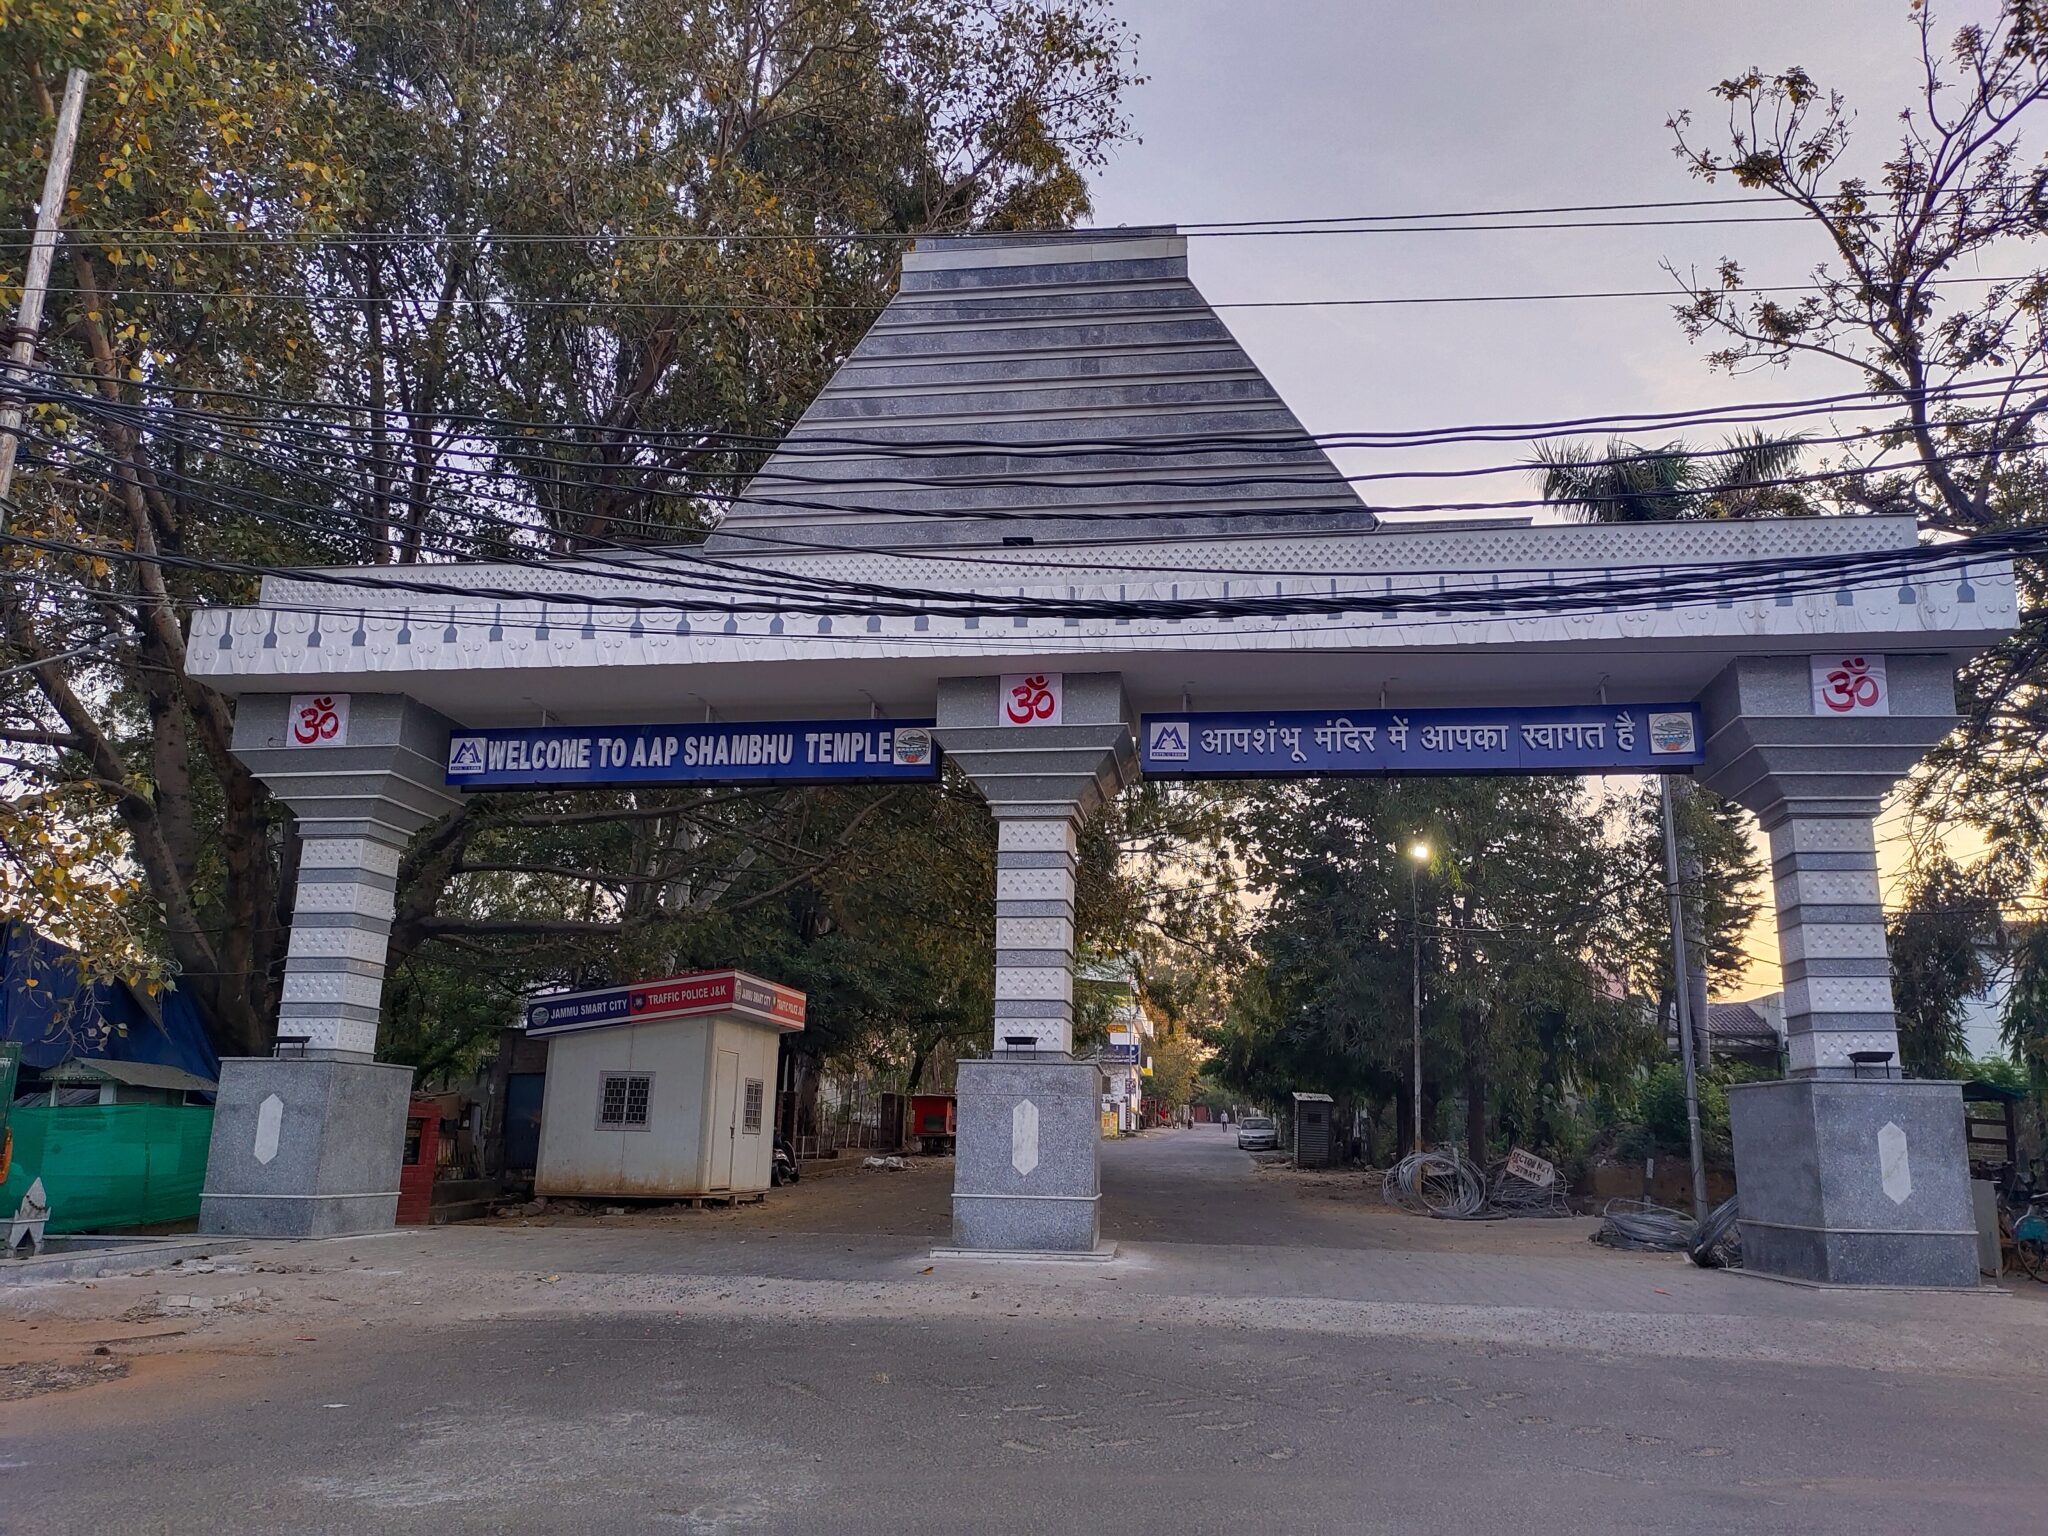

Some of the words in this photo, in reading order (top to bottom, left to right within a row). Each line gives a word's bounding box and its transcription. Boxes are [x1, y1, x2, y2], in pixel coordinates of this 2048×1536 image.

[488, 738, 592, 771] WELCOME
[598, 737, 627, 768] TO
[630, 736, 679, 768] AAP
[684, 734, 793, 766] SHAMBHU
[805, 731, 891, 764] TEMPLE
[1200, 720, 1307, 762] आपशंभू
[1314, 718, 1377, 752] मंदिर
[1388, 715, 1410, 751] में
[1421, 725, 1509, 751] आपका
[1521, 722, 1607, 750] स्वागत
[1614, 711, 1636, 750] है
[550, 1004, 579, 1020] JAMMU
[580, 1001, 608, 1015] SMART
[609, 999, 628, 1012] CITY
[648, 992, 680, 1006] TRAFFIC
[681, 988, 709, 1001] POLICE
[710, 984, 727, 998] J&K
